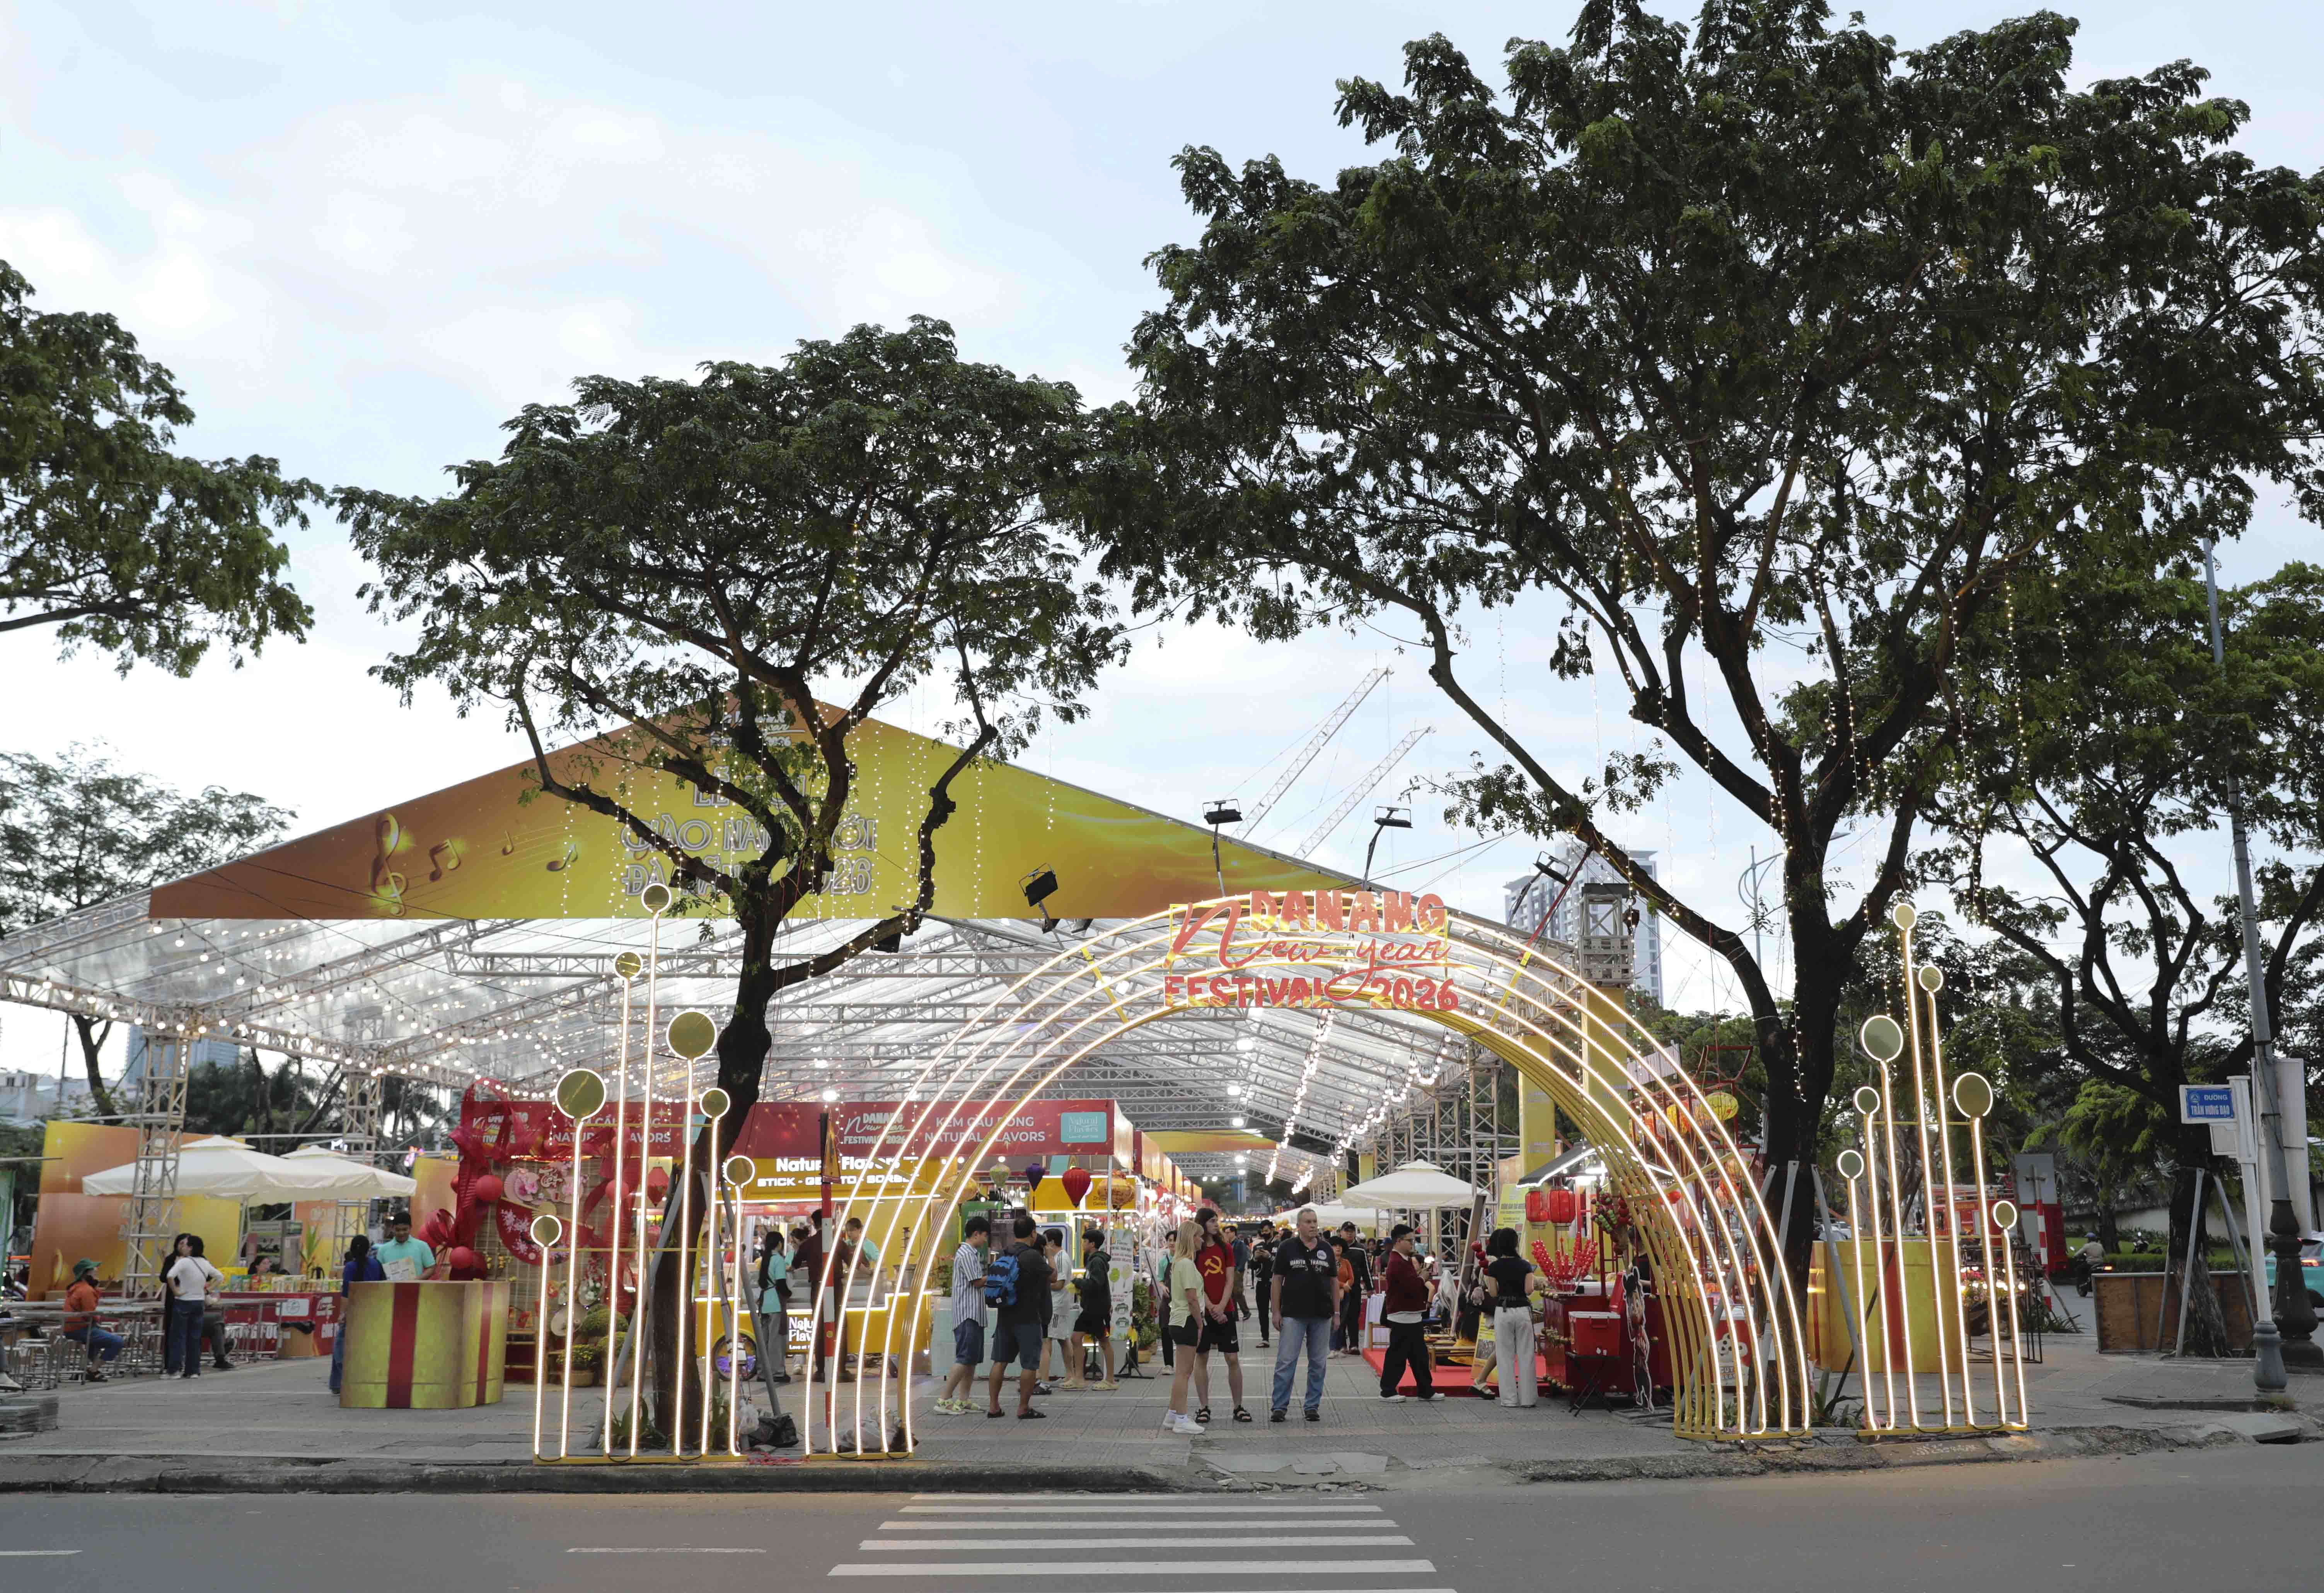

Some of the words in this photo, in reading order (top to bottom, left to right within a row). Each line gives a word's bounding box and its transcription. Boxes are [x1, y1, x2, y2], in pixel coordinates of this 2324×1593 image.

[1250, 890, 1445, 933] DANANG
[1161, 899, 1333, 969] New
[1164, 976, 1334, 1009] FESTIVAL
[1370, 978, 1458, 1010] 2026
[631, 1132, 672, 1143] AVORS
[991, 1131, 1045, 1142] LAVORS
[776, 1158, 822, 1172] Natur
[757, 1177, 796, 1188] STICK
[805, 1176, 857, 1186] GETO
